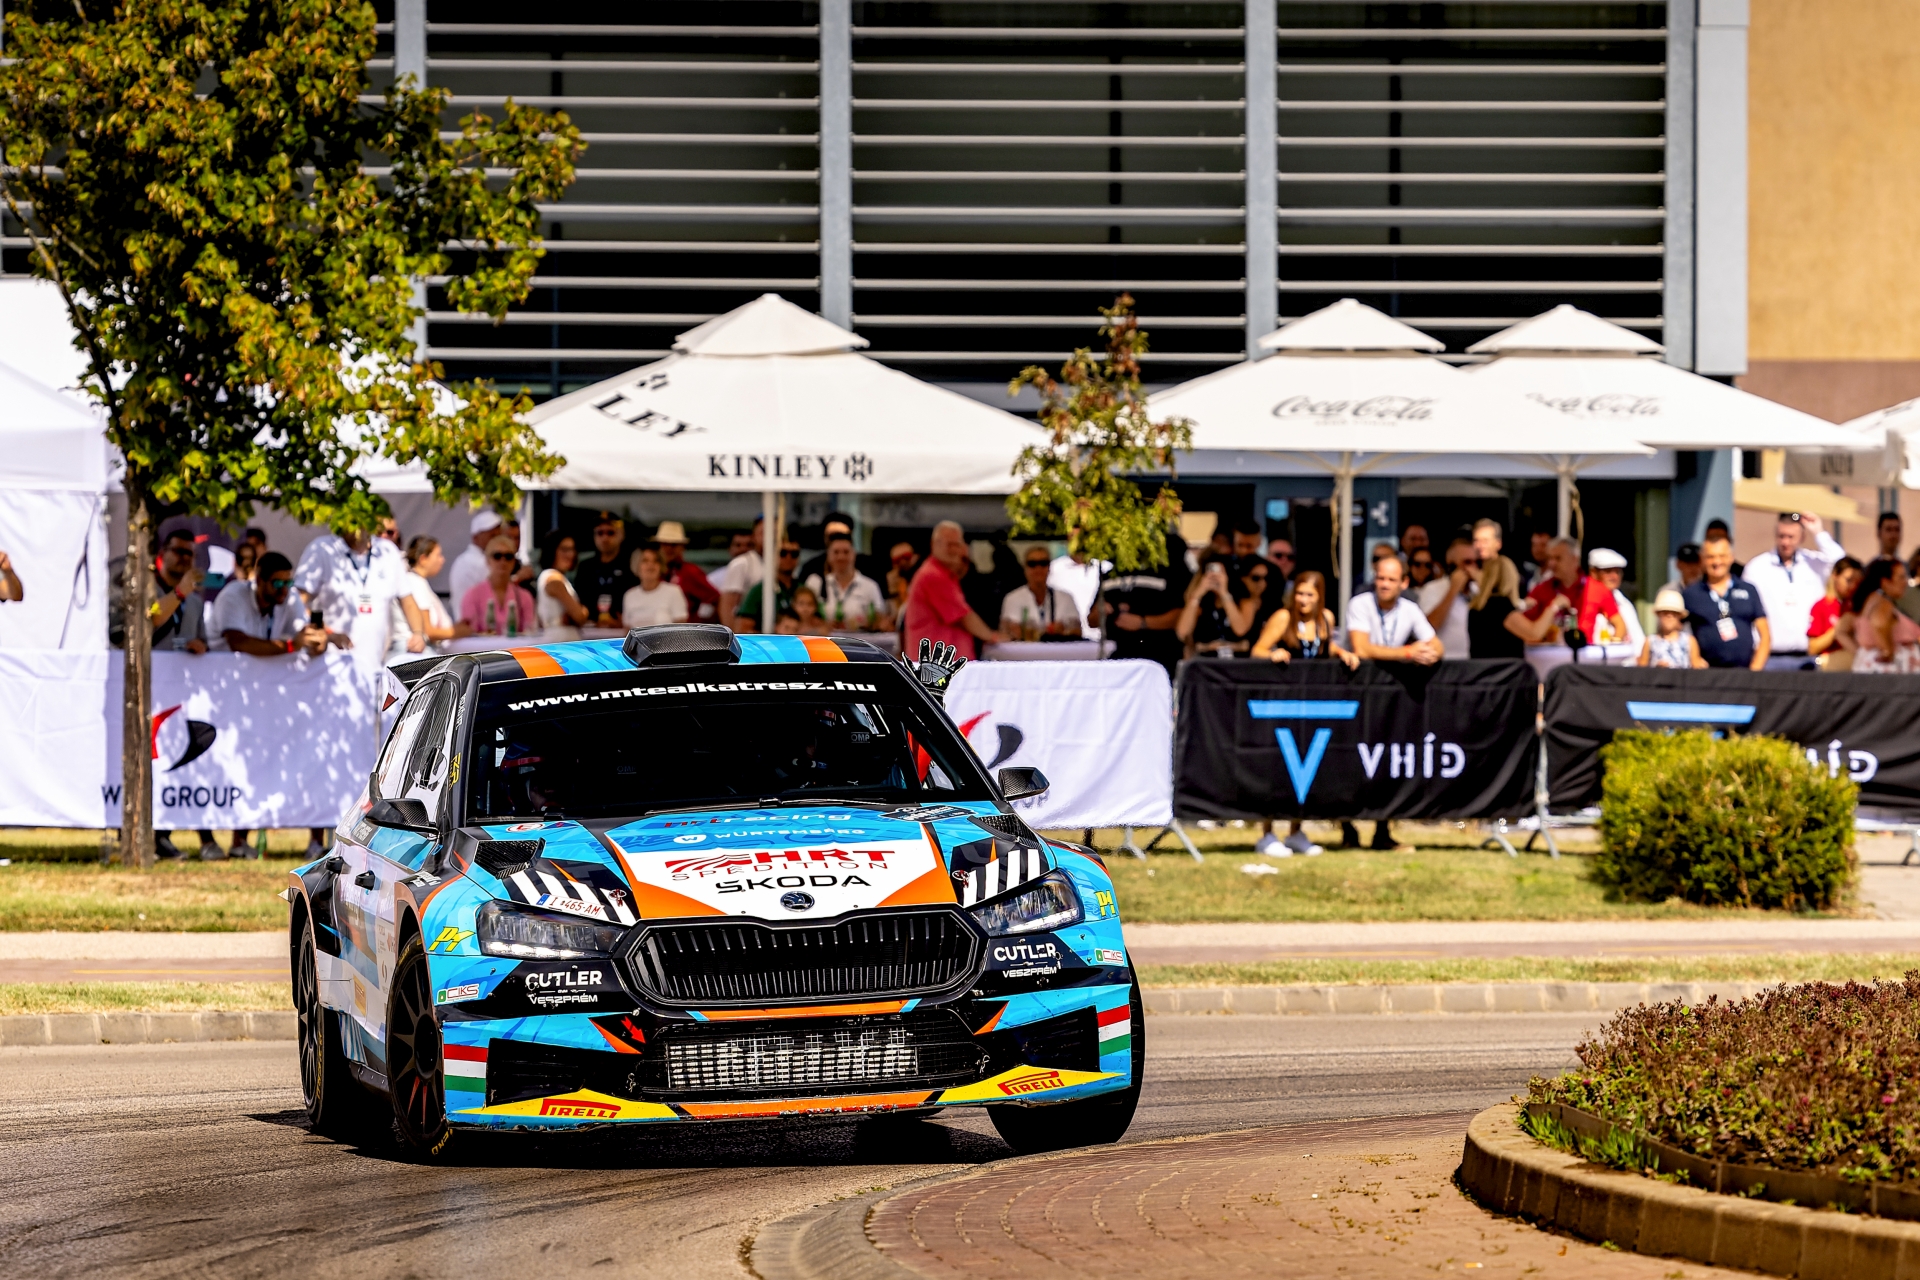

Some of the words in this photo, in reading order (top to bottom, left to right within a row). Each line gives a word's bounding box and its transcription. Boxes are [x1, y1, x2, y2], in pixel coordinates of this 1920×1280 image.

[707, 454, 835, 479] KINLEY
[507, 680, 877, 711] www.mtealkatresz.hu
[161, 785, 242, 808] GROUP
[754, 849, 896, 864] HRT
[671, 861, 889, 881] SPEDITION
[993, 943, 1057, 962] CUTLER
[525, 970, 603, 988] CUTLER
[1002, 965, 1057, 978] VESZPRÉM
[530, 993, 598, 1005] VESZPRÉM
[997, 1070, 1065, 1096] PIRELLI
[539, 1098, 622, 1119] PIRELLI
